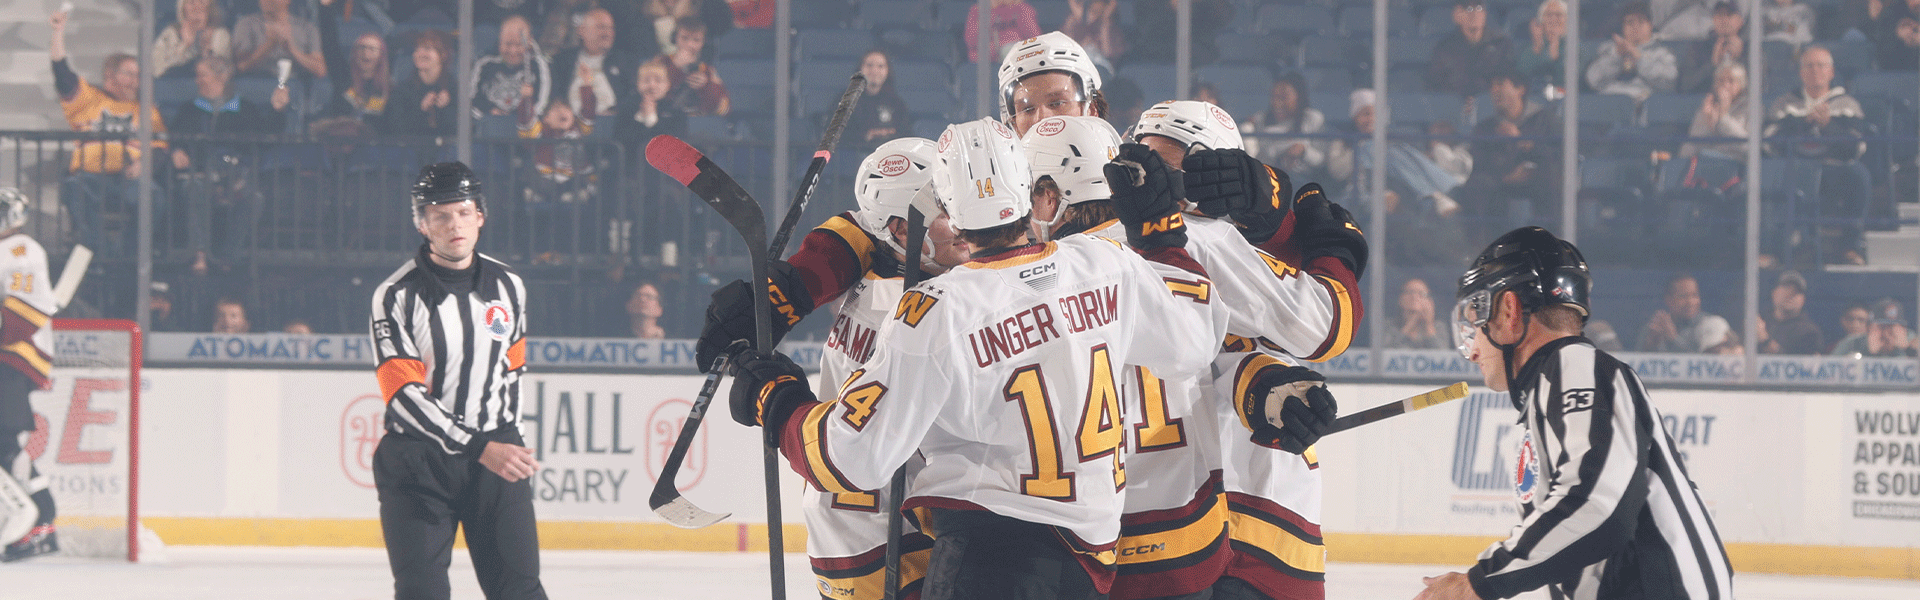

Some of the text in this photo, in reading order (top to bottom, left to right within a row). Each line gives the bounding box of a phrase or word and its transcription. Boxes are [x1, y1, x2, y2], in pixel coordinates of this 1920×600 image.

[882, 159, 905, 167] Jewel
[800, 172, 819, 213] CCM
[976, 177, 995, 199] 14
[1141, 211, 1184, 237] CM
[9, 271, 34, 294] 31
[1019, 262, 1056, 280] CCM
[767, 276, 801, 327] CM
[893, 290, 939, 329] W
[968, 283, 1119, 369] UNGER SORUM
[188, 337, 331, 359] ATOMATIC
[526, 341, 648, 363] TOMATIC
[1630, 359, 1742, 379] ATIC HVAC
[1758, 361, 1917, 382] ATOMATIC HVAC
[1562, 391, 1595, 413] 53
[1003, 342, 1127, 502] 14
[1854, 410, 1920, 435] WOLV
[1852, 440, 1920, 465] APPA
[530, 467, 629, 502] SARY
[1853, 471, 1869, 494] &
[1121, 542, 1165, 557] CCM
